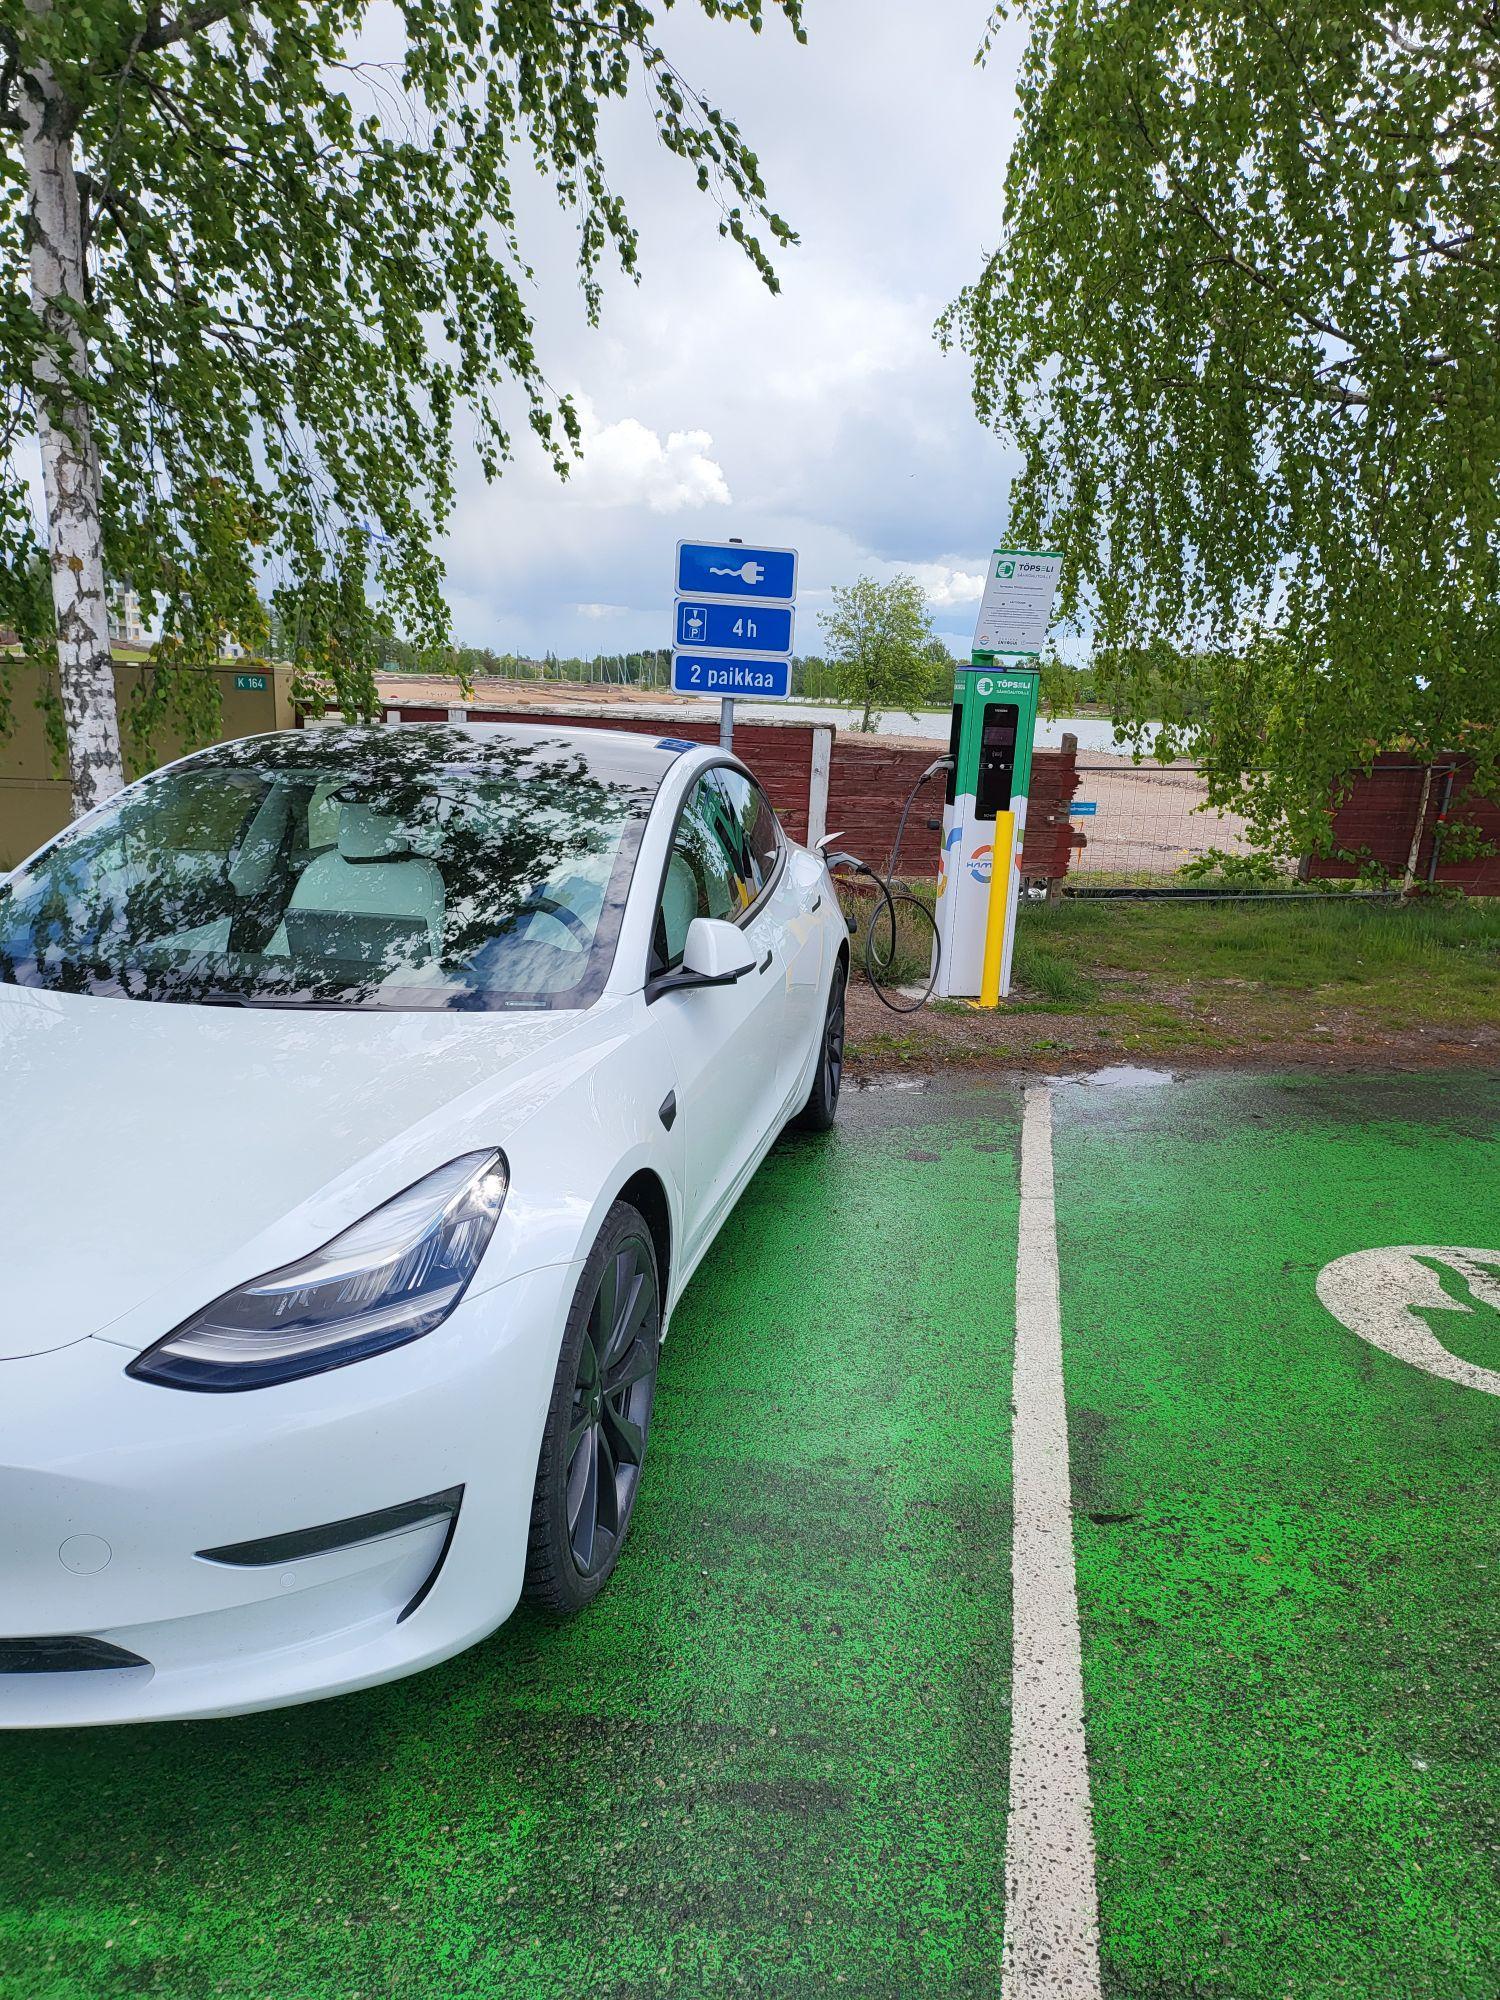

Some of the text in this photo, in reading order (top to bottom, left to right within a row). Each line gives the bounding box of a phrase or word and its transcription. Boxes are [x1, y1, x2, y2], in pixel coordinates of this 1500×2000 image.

[1019, 562, 1054, 573] TÖPSELI
[692, 629, 699, 637] P
[732, 618, 757, 638] 4 h
[690, 664, 774, 688] 2 paikkaa
[237, 677, 263, 688] K 164
